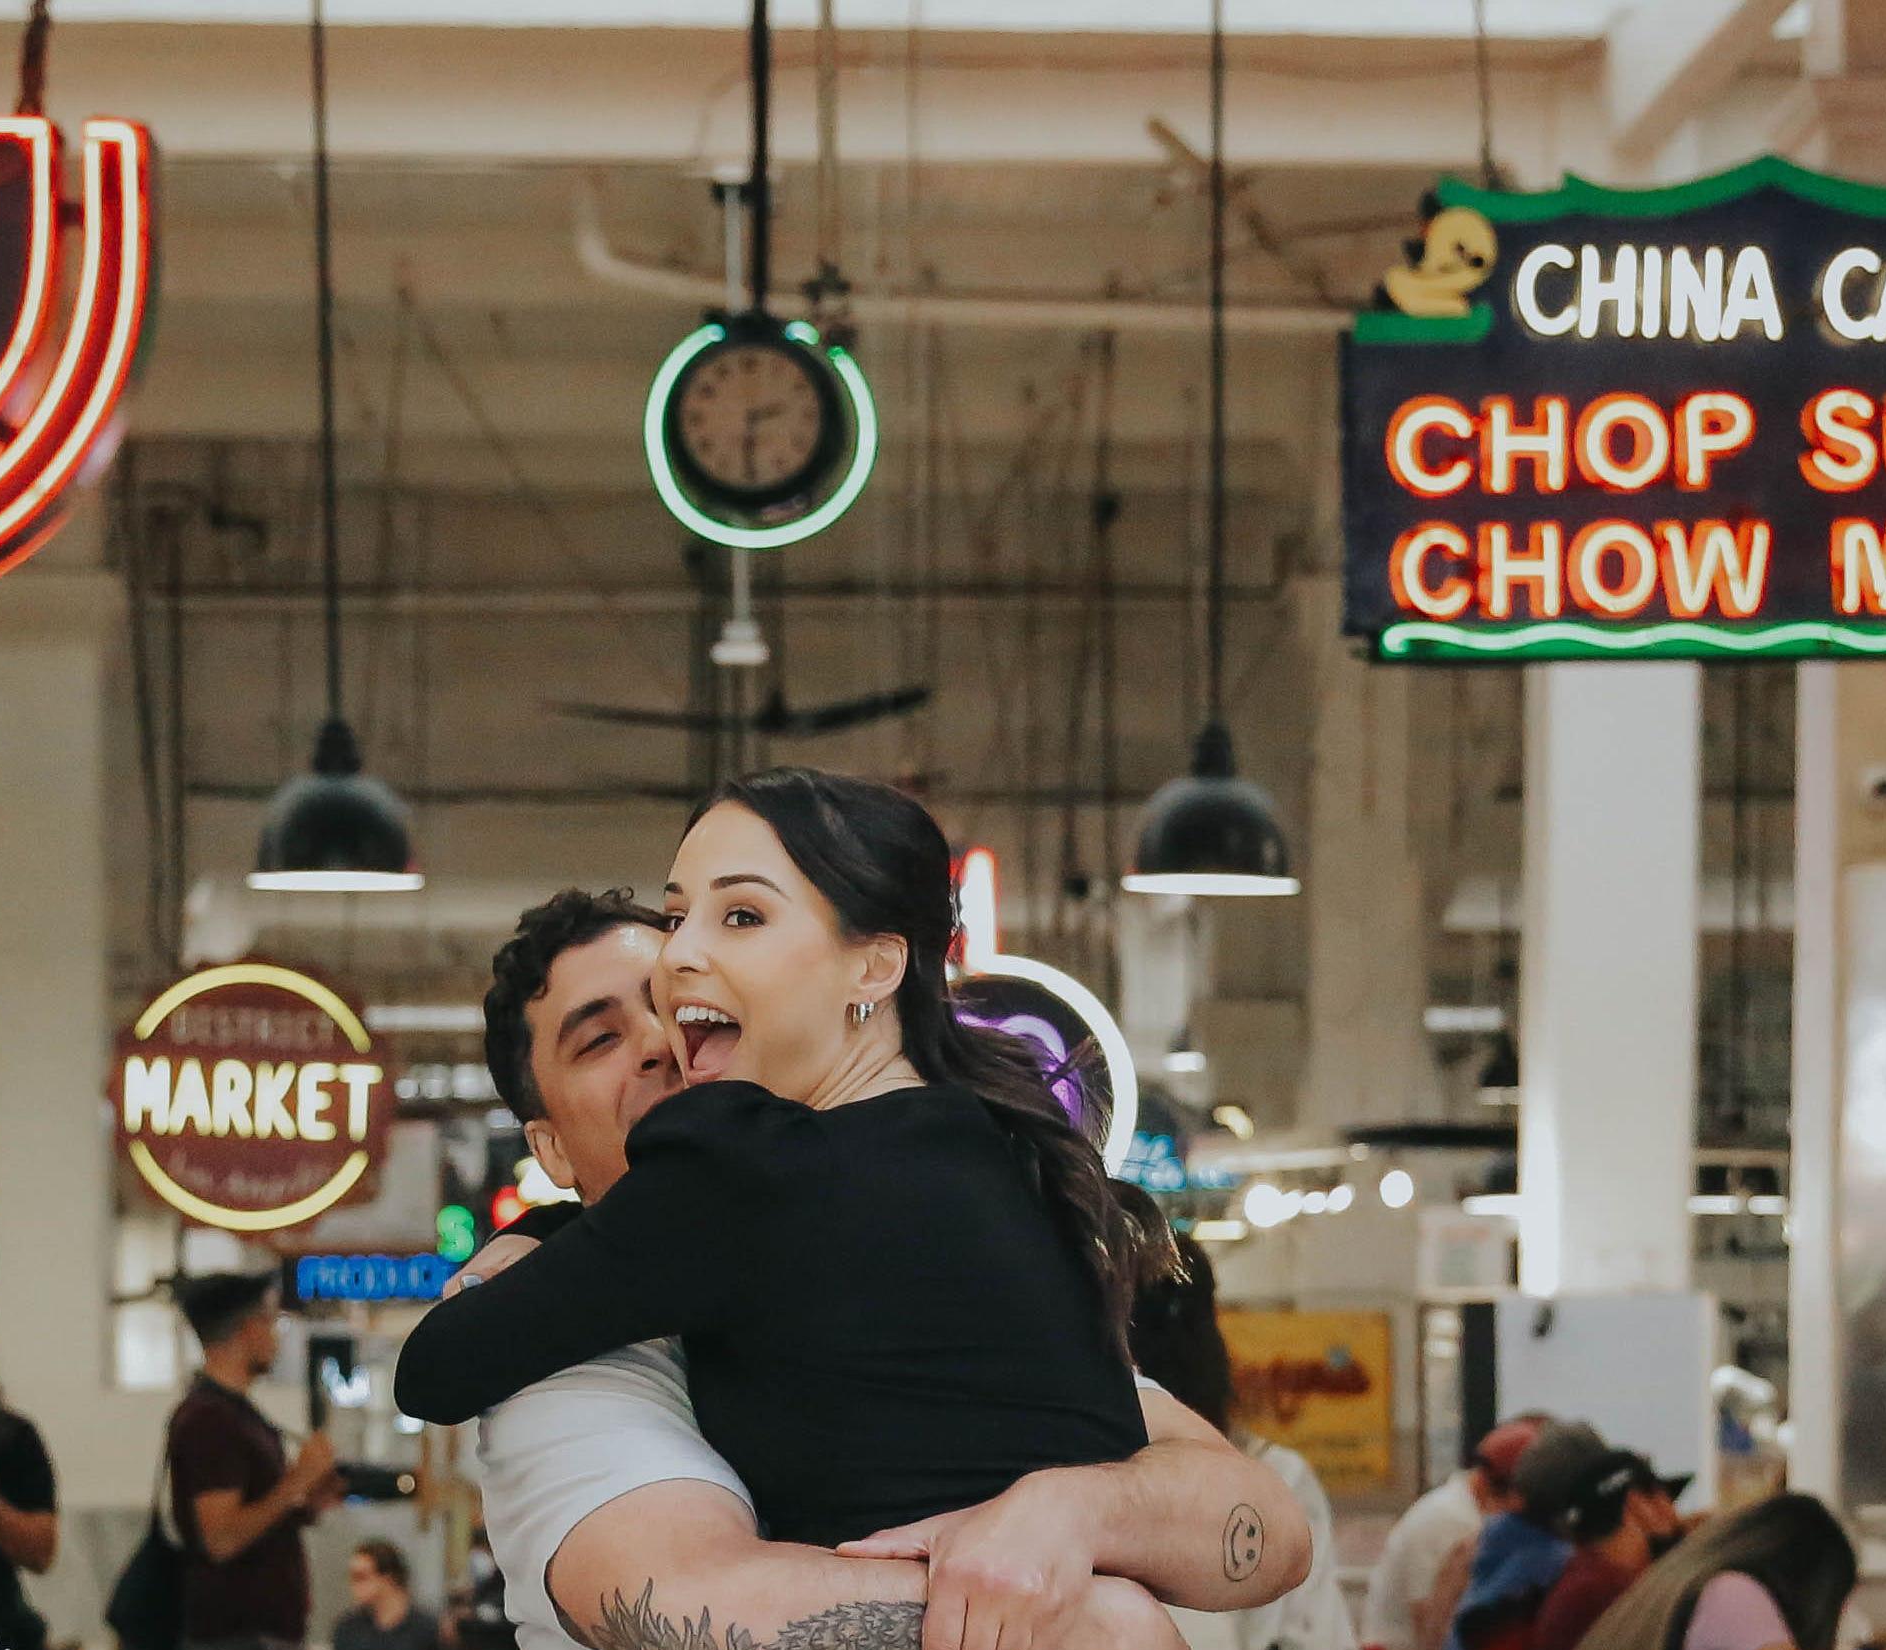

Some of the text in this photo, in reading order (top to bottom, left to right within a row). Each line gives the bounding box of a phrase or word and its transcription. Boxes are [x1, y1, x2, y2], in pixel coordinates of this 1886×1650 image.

[1514, 243, 1785, 342] CHINA
[1384, 393, 1756, 498] CHOP
[1387, 518, 1772, 620] CHOW
[123, 1056, 383, 1142] MARKET
